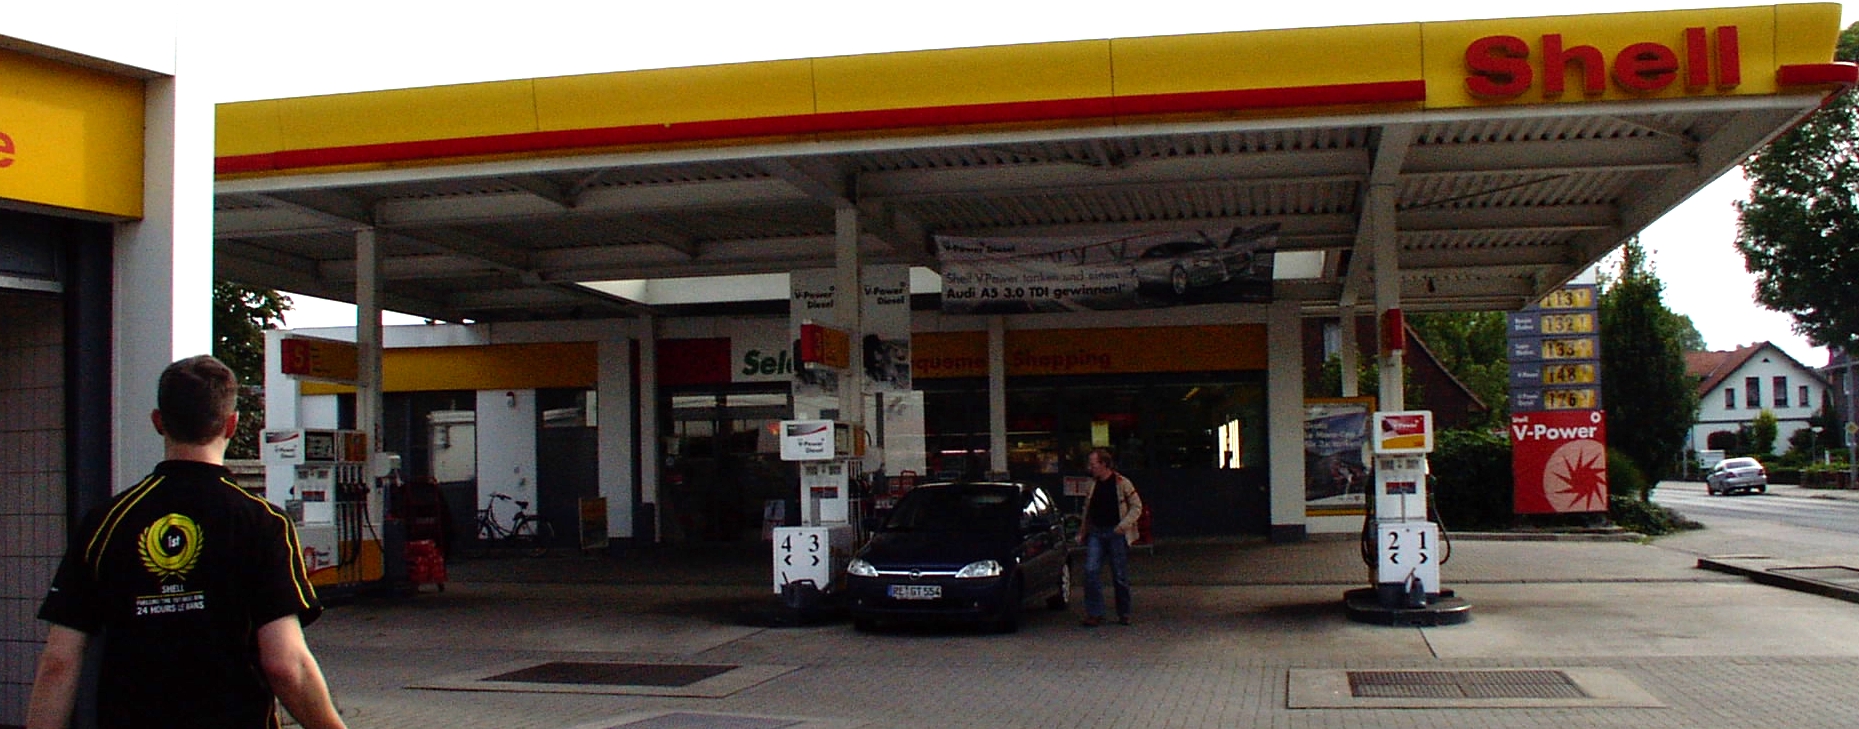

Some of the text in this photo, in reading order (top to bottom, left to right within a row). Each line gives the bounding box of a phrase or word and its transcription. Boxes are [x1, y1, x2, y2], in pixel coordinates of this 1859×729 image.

[1464, 25, 1741, 98] Shell
[1022, 273, 1059, 282] tanken
[1063, 269, 1084, 281] und
[794, 290, 834, 300] V-Power
[864, 286, 904, 296] V-Power
[946, 286, 977, 299] Audi
[980, 286, 999, 299] A5
[1003, 286, 1025, 299] 3.0
[1028, 286, 1049, 298] TDI
[806, 300, 835, 309] Diesel
[877, 296, 906, 305] Diesel
[742, 350, 793, 375] Sel
[911, 349, 1111, 373] queme Shopping
[1512, 423, 1598, 441] V-Power
[781, 535, 819, 552] 4 3
[1388, 531, 1427, 550] 2 1
[161, 584, 185, 594] SHELL
[136, 605, 149, 616] 24
[150, 603, 177, 614] HOURS
